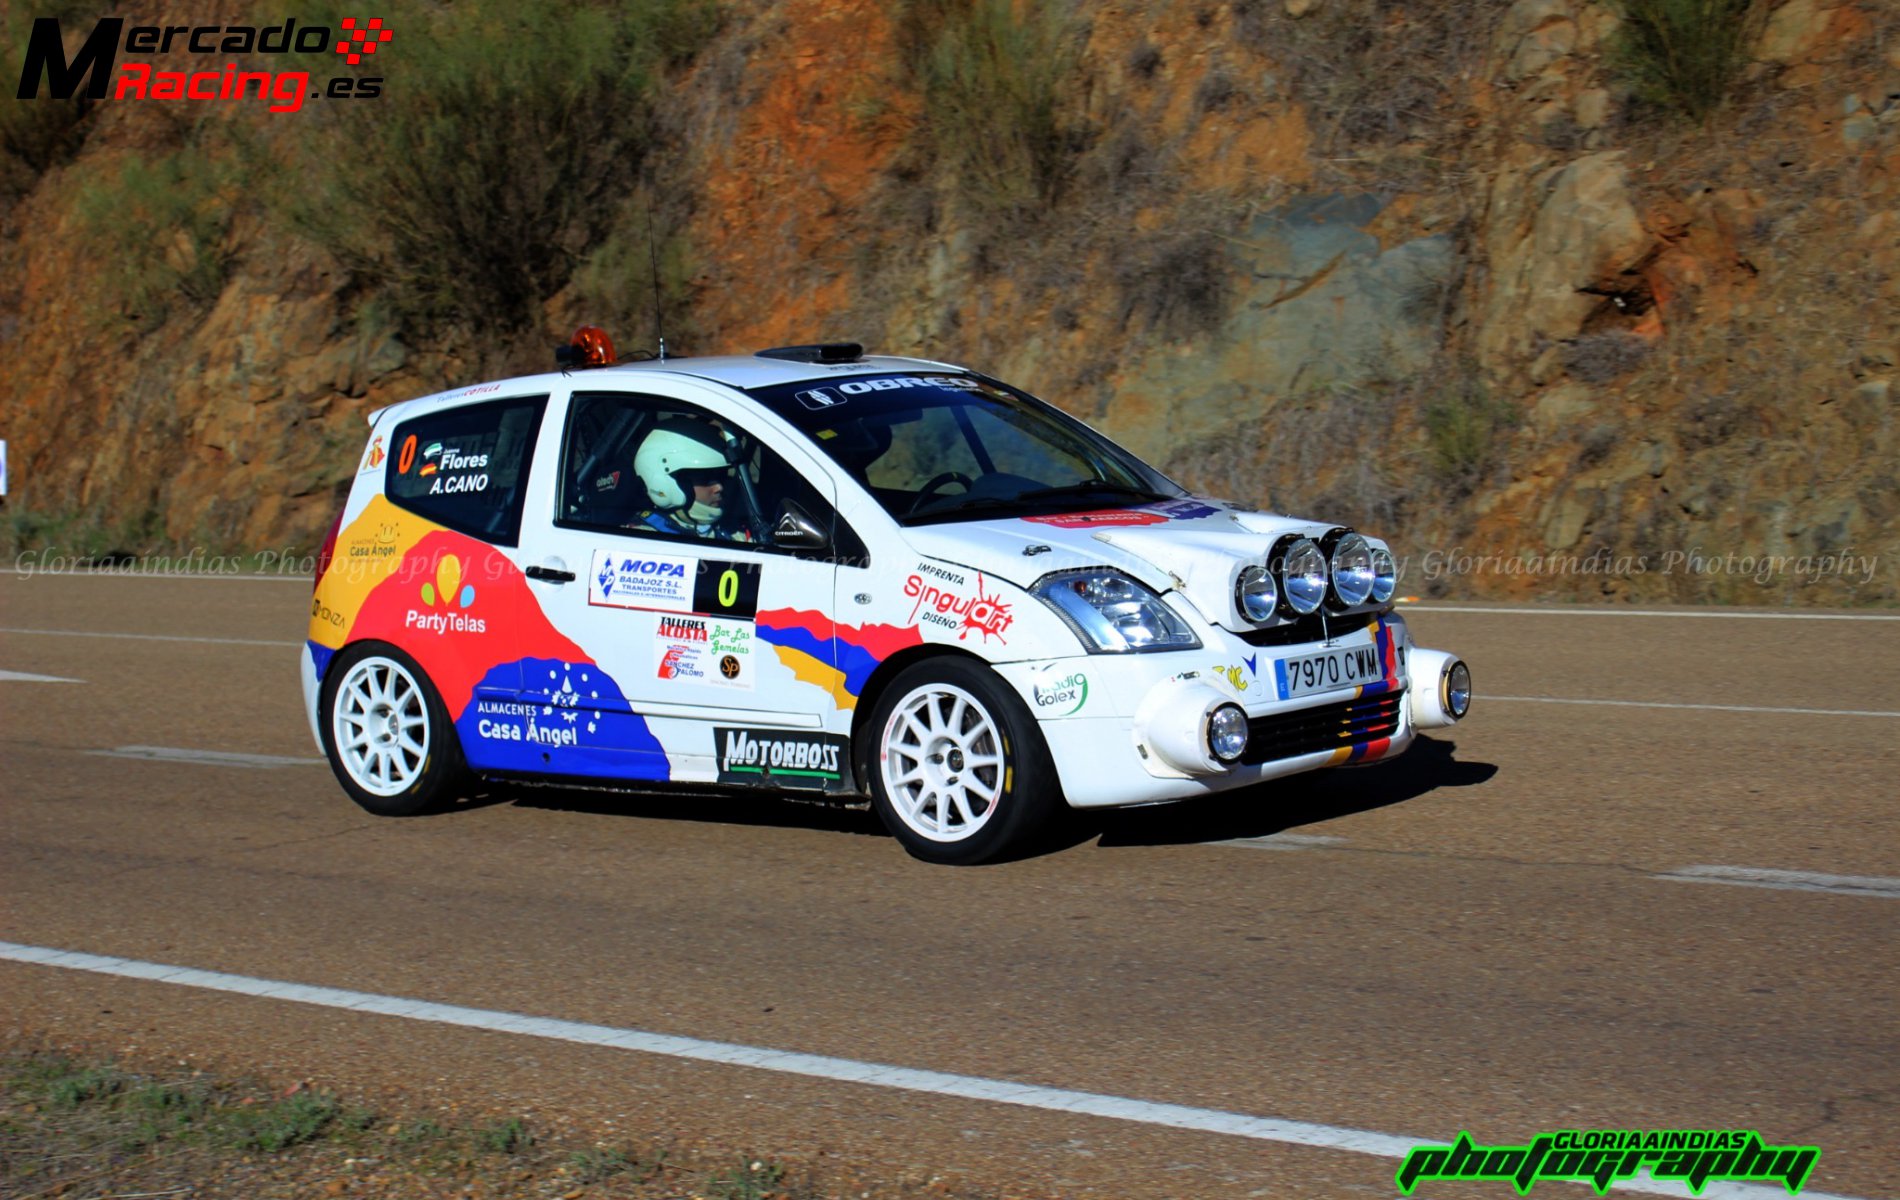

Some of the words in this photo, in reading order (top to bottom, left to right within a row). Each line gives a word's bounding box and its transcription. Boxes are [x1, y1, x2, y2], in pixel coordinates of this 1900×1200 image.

[398, 434, 417, 475] 0
[440, 454, 488, 470] Flores
[429, 474, 489, 495] A.CANO
[350, 546, 369, 557] Casa
[620, 559, 684, 577] MOPA
[917, 562, 965, 585] IMPRENTA
[620, 576, 662, 586] BADAJOZ
[622, 584, 677, 594] TRANSPORTES
[718, 570, 738, 607] 0
[405, 609, 486, 634] PartyTelas
[661, 616, 706, 630] TALLERES
[657, 624, 707, 642] ACOSTA
[709, 625, 730, 640] Bar
[731, 628, 750, 643] Las
[711, 640, 749, 655] Gemelas
[1289, 655, 1339, 690] 7970
[1345, 648, 1378, 680] CWM
[478, 702, 537, 716] ALMACENES
[478, 719, 521, 741] Casa
